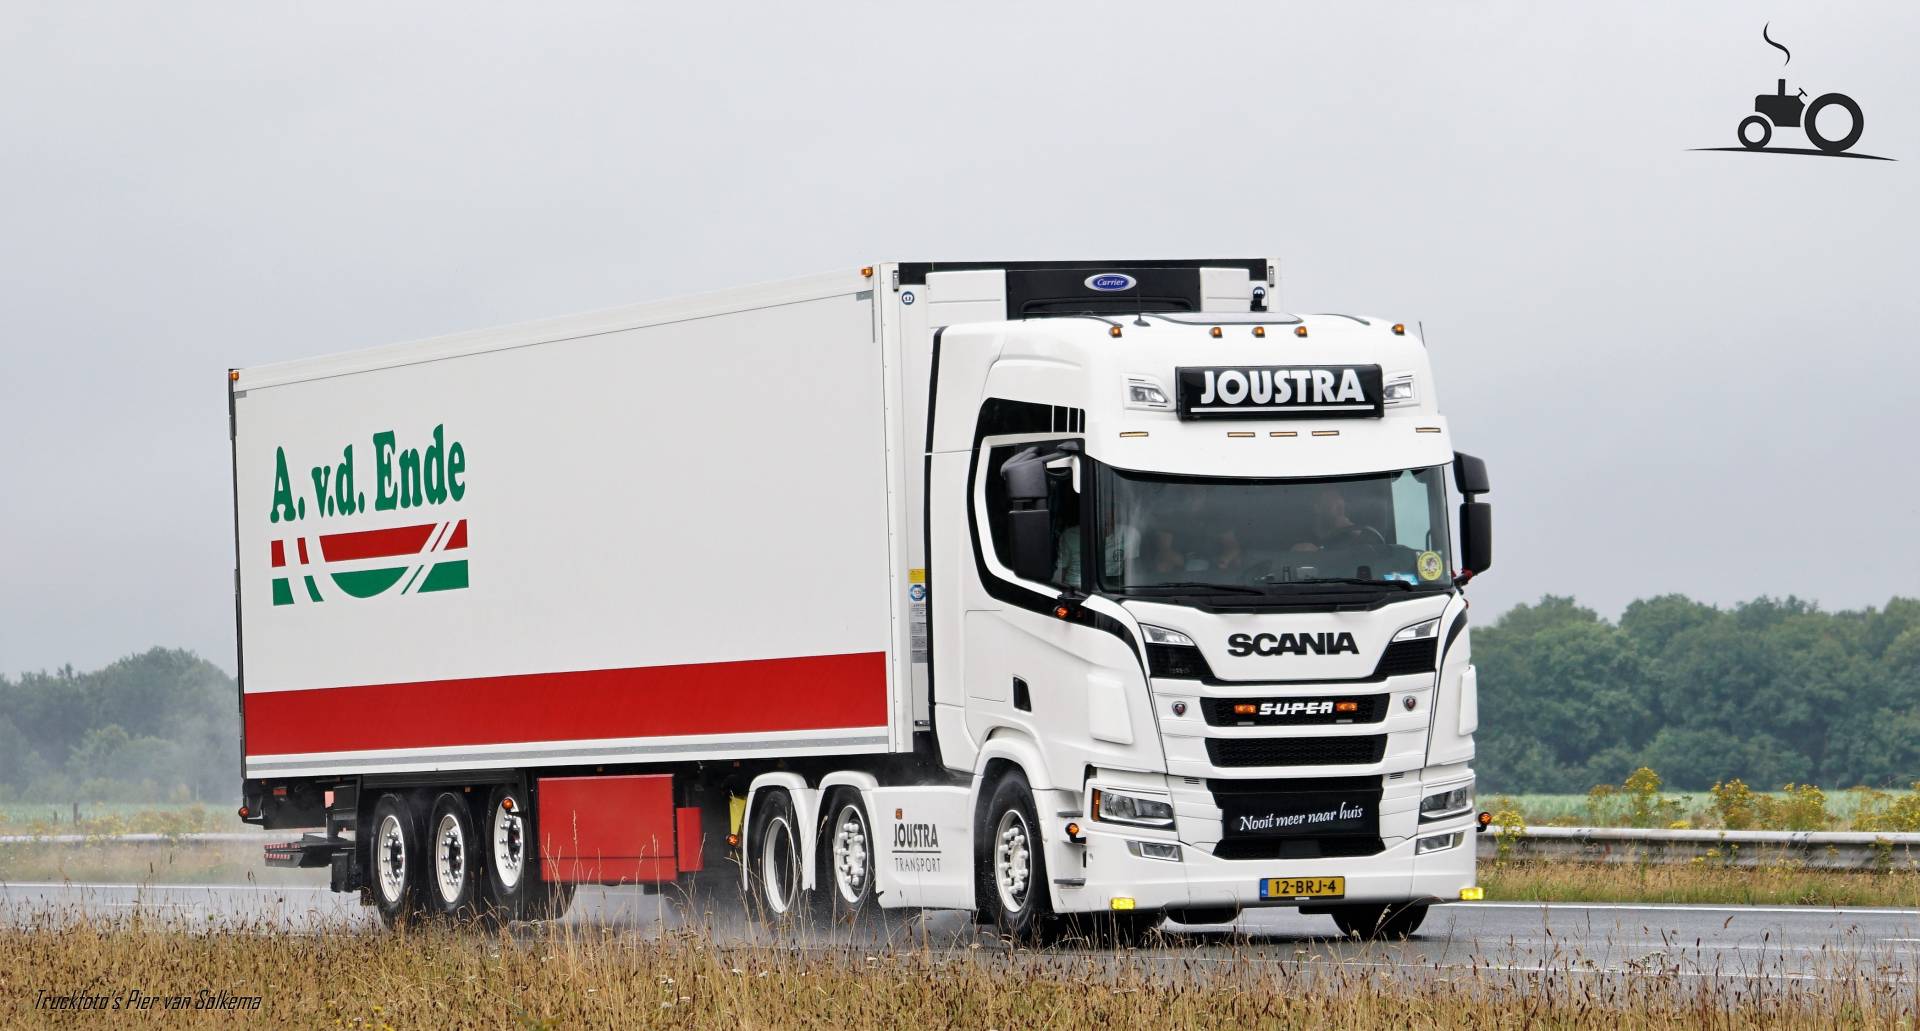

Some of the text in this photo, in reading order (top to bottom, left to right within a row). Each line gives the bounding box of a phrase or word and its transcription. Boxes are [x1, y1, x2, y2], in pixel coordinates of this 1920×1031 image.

[1097, 278, 1125, 287] Carrier
[1201, 369, 1365, 405] JOUSTRA
[270, 423, 466, 524] A. v.d. Ende
[1227, 632, 1360, 657] SCANIA
[1259, 701, 1334, 715] SUPER
[1239, 801, 1363, 831] Nooit meer naar huis
[893, 823, 939, 848] JOUSTRA
[894, 857, 941, 873] TRANSPORT
[1275, 880, 1337, 894] 12-BRJ-4
